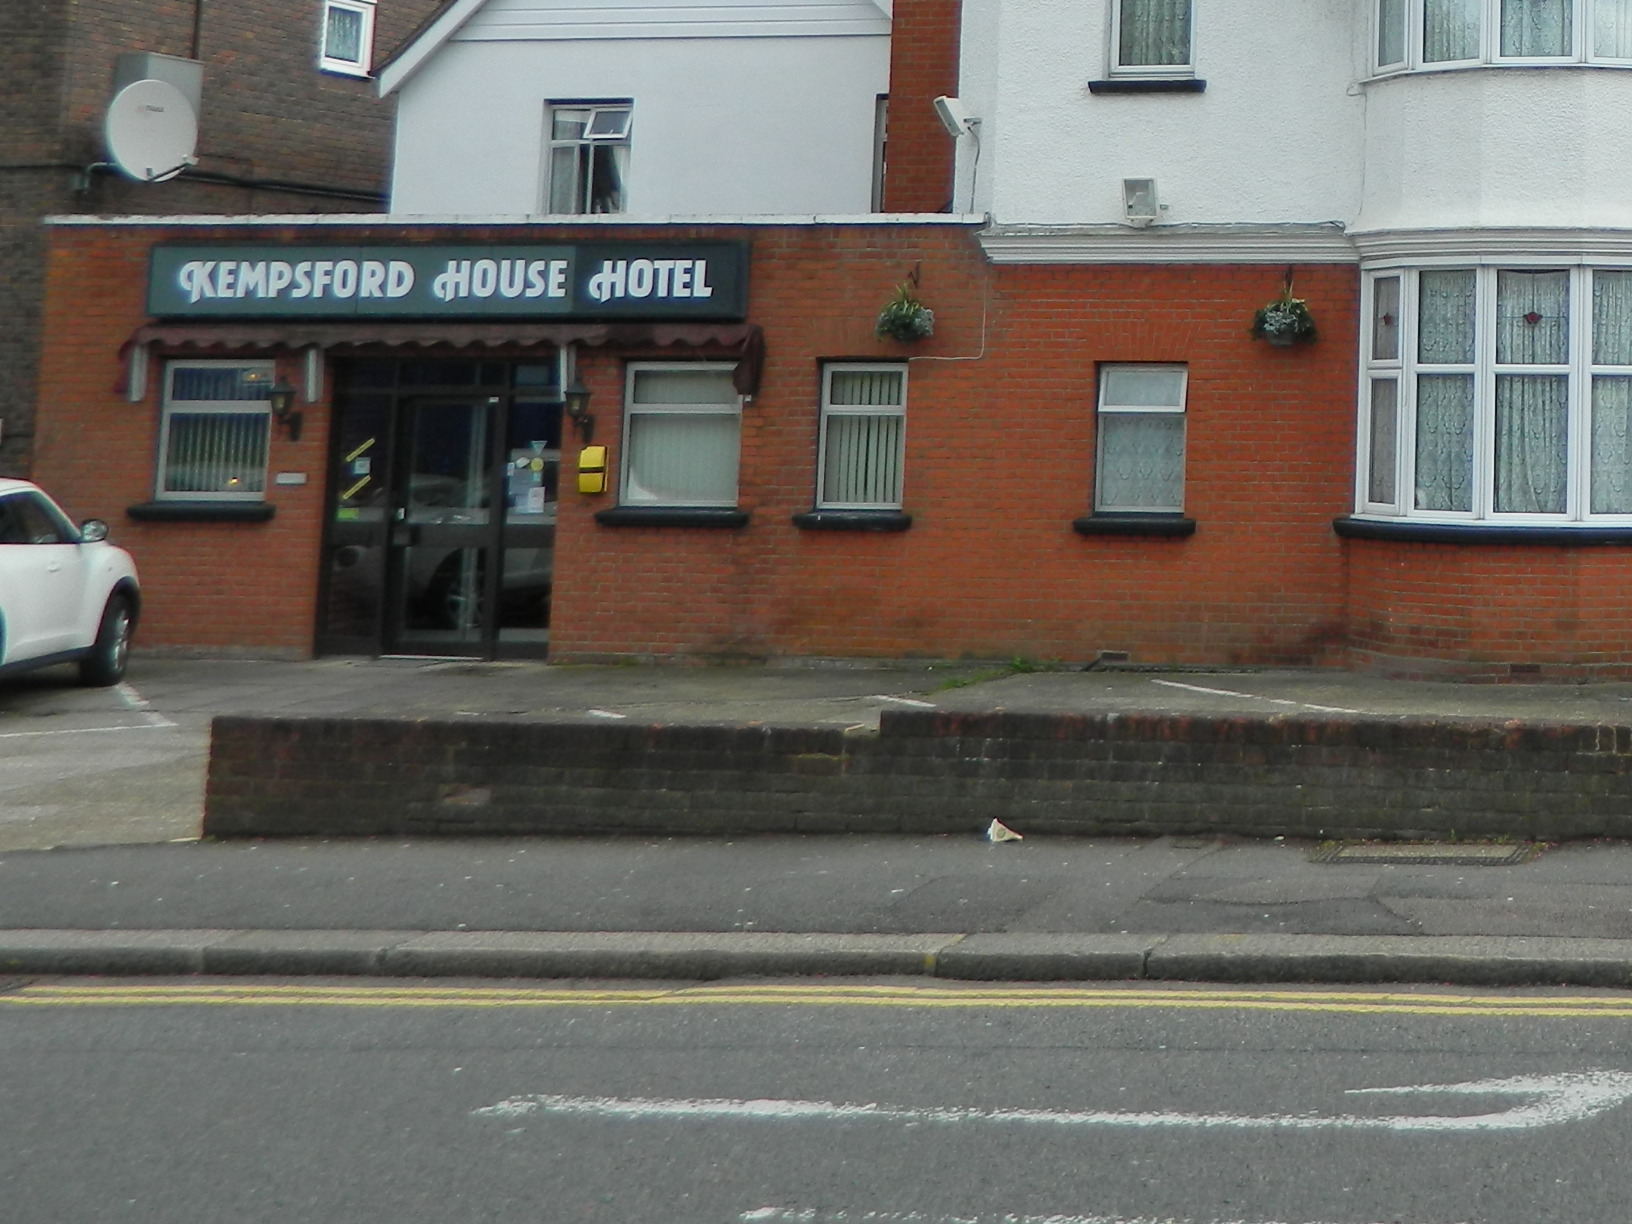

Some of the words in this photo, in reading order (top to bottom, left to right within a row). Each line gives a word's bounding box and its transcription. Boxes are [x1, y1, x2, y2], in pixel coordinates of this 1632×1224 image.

[179, 259, 415, 304] KEMPSFORD
[433, 258, 568, 303] HOUSE
[589, 258, 713, 304] HOTEL
